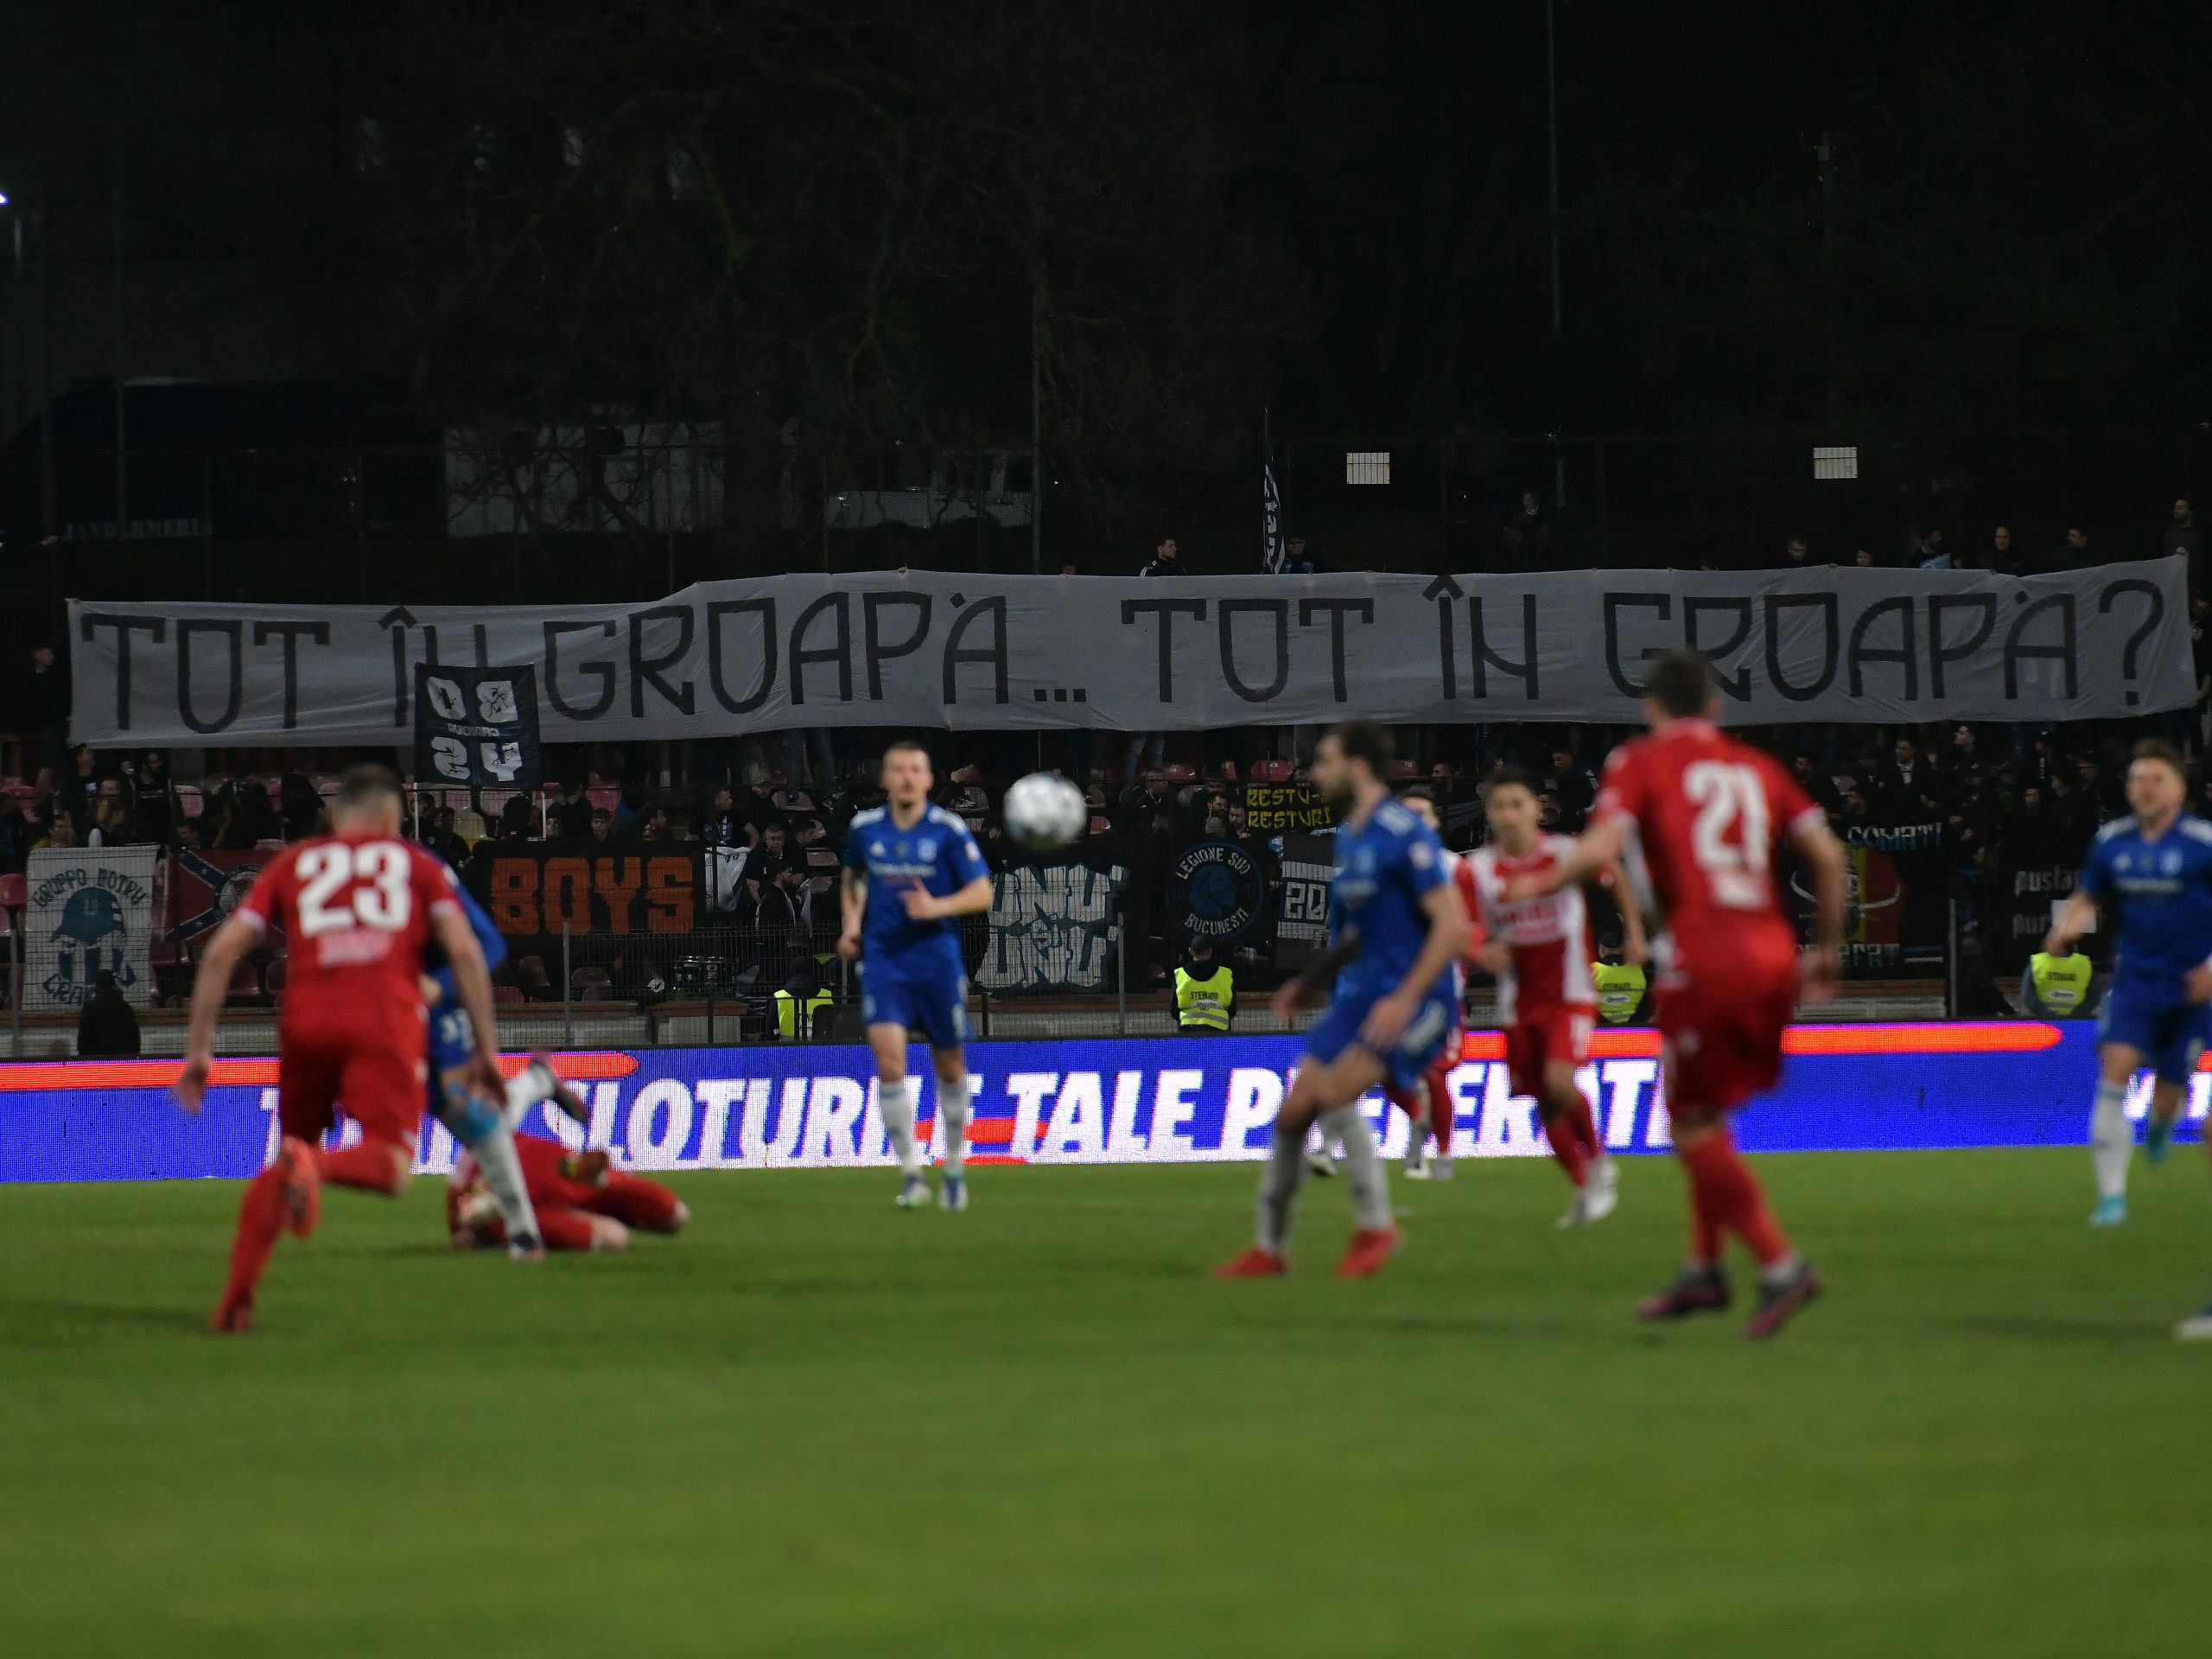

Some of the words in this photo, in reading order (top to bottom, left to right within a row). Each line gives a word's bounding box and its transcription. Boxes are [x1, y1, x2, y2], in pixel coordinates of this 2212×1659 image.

[82, 613, 330, 734] TOT
[1122, 598, 1375, 703] TOT
[1423, 575, 1539, 701] ÎN
[295, 842, 411, 938] 23
[490, 856, 695, 936] BOYS
[1175, 847, 1225, 880] LEGIONE
[1227, 852, 1252, 874] SUD
[1000, 1068, 1205, 1160] TALE
